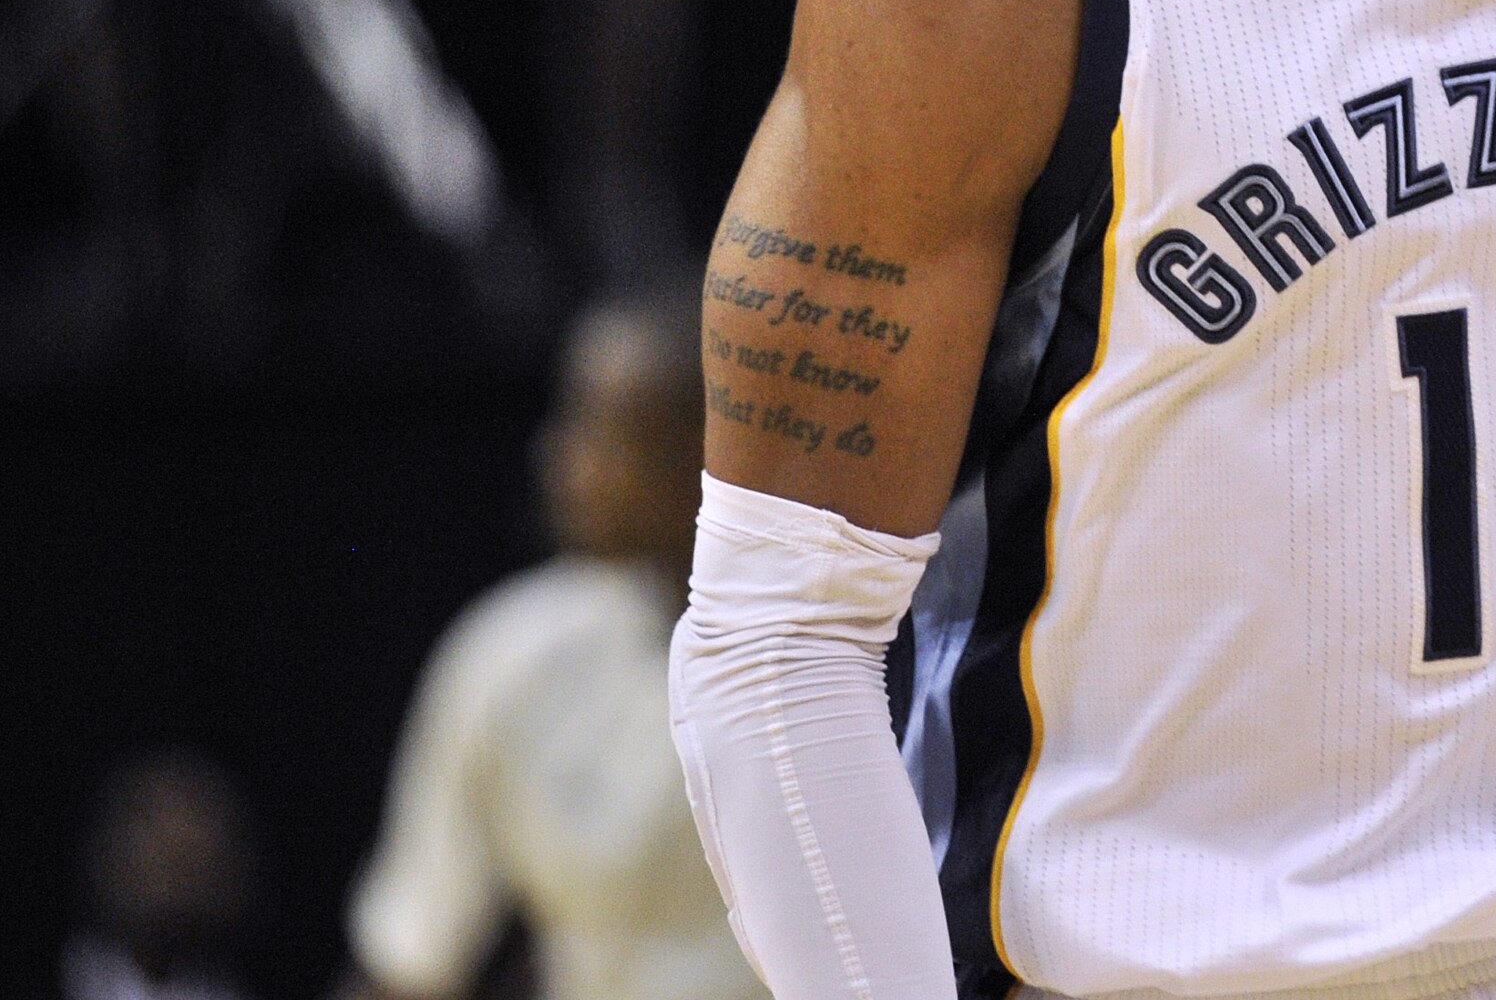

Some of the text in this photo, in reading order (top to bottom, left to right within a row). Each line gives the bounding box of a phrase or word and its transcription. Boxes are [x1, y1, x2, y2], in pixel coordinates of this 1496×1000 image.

[824, 244, 907, 286] them
[768, 288, 831, 326] for
[838, 304, 911, 354] they
[736, 345, 785, 375] not
[790, 351, 881, 396] know
[761, 404, 827, 453] they
[836, 420, 876, 456] do
